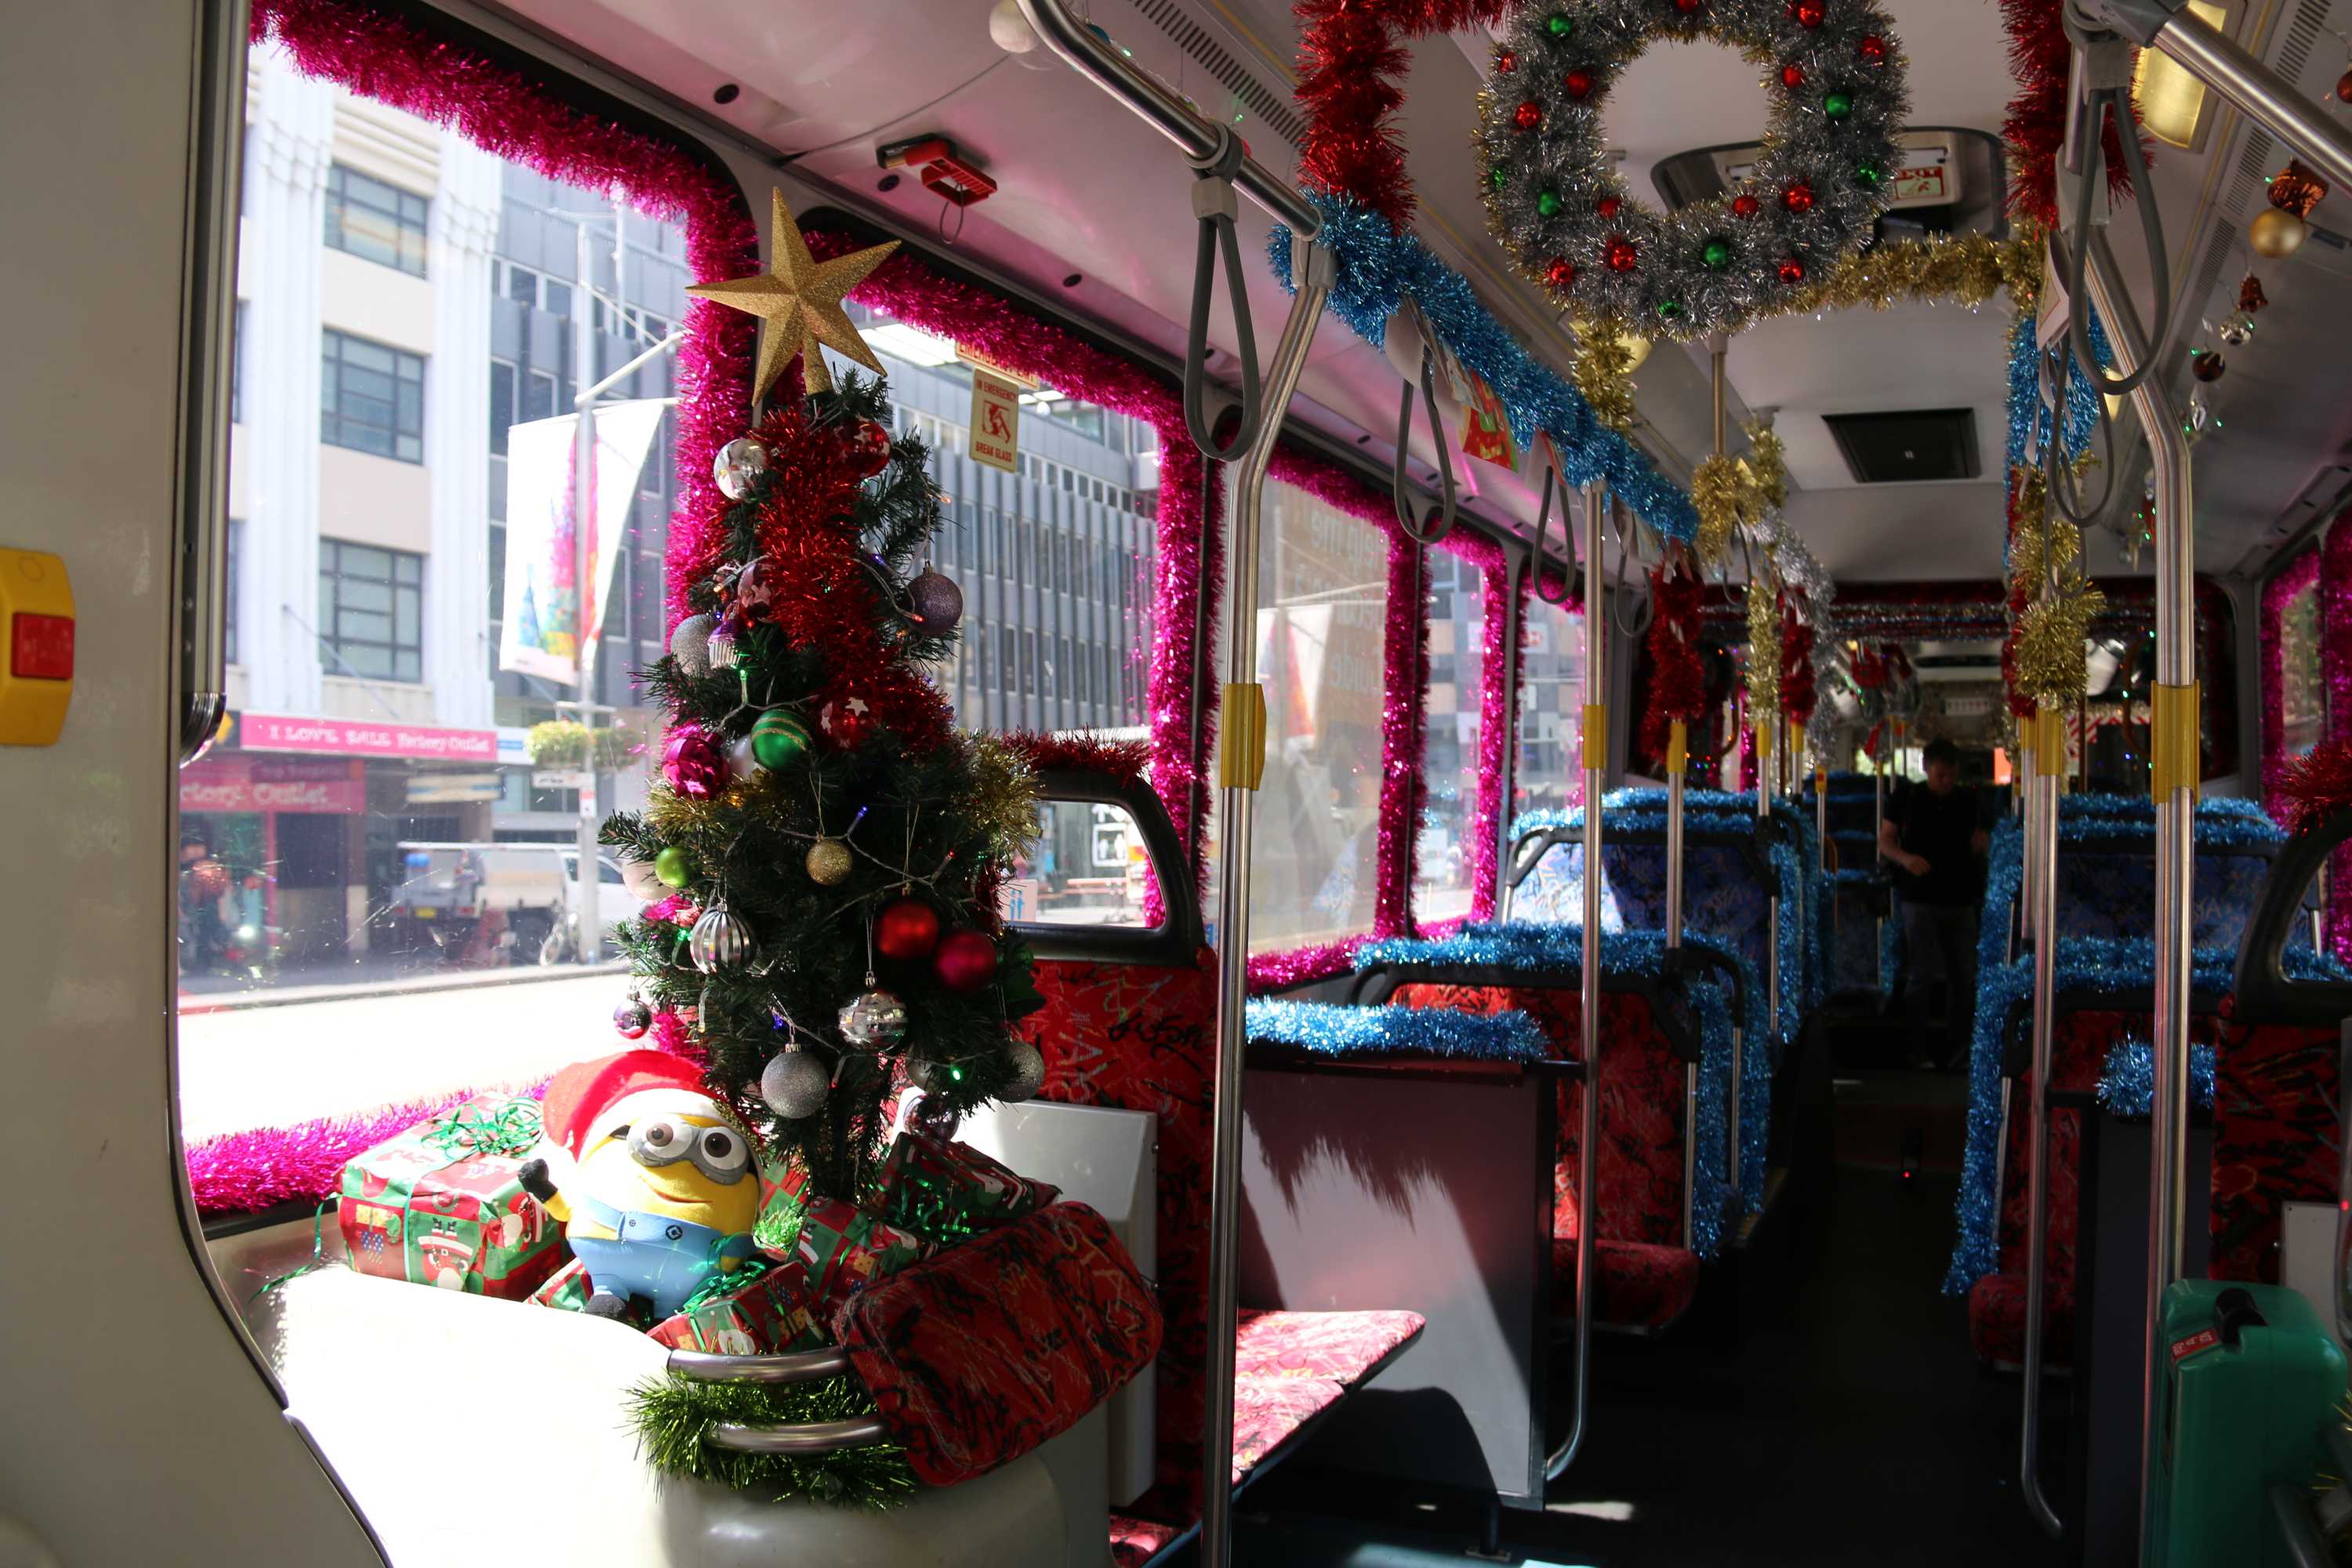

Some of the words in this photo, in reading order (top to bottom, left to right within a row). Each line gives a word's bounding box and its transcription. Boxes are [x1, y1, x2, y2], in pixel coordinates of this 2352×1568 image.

[984, 382, 1017, 401] EMERGENCY
[975, 441, 994, 458] BREAK
[995, 446, 1013, 463] GLASS
[270, 724, 279, 740] I
